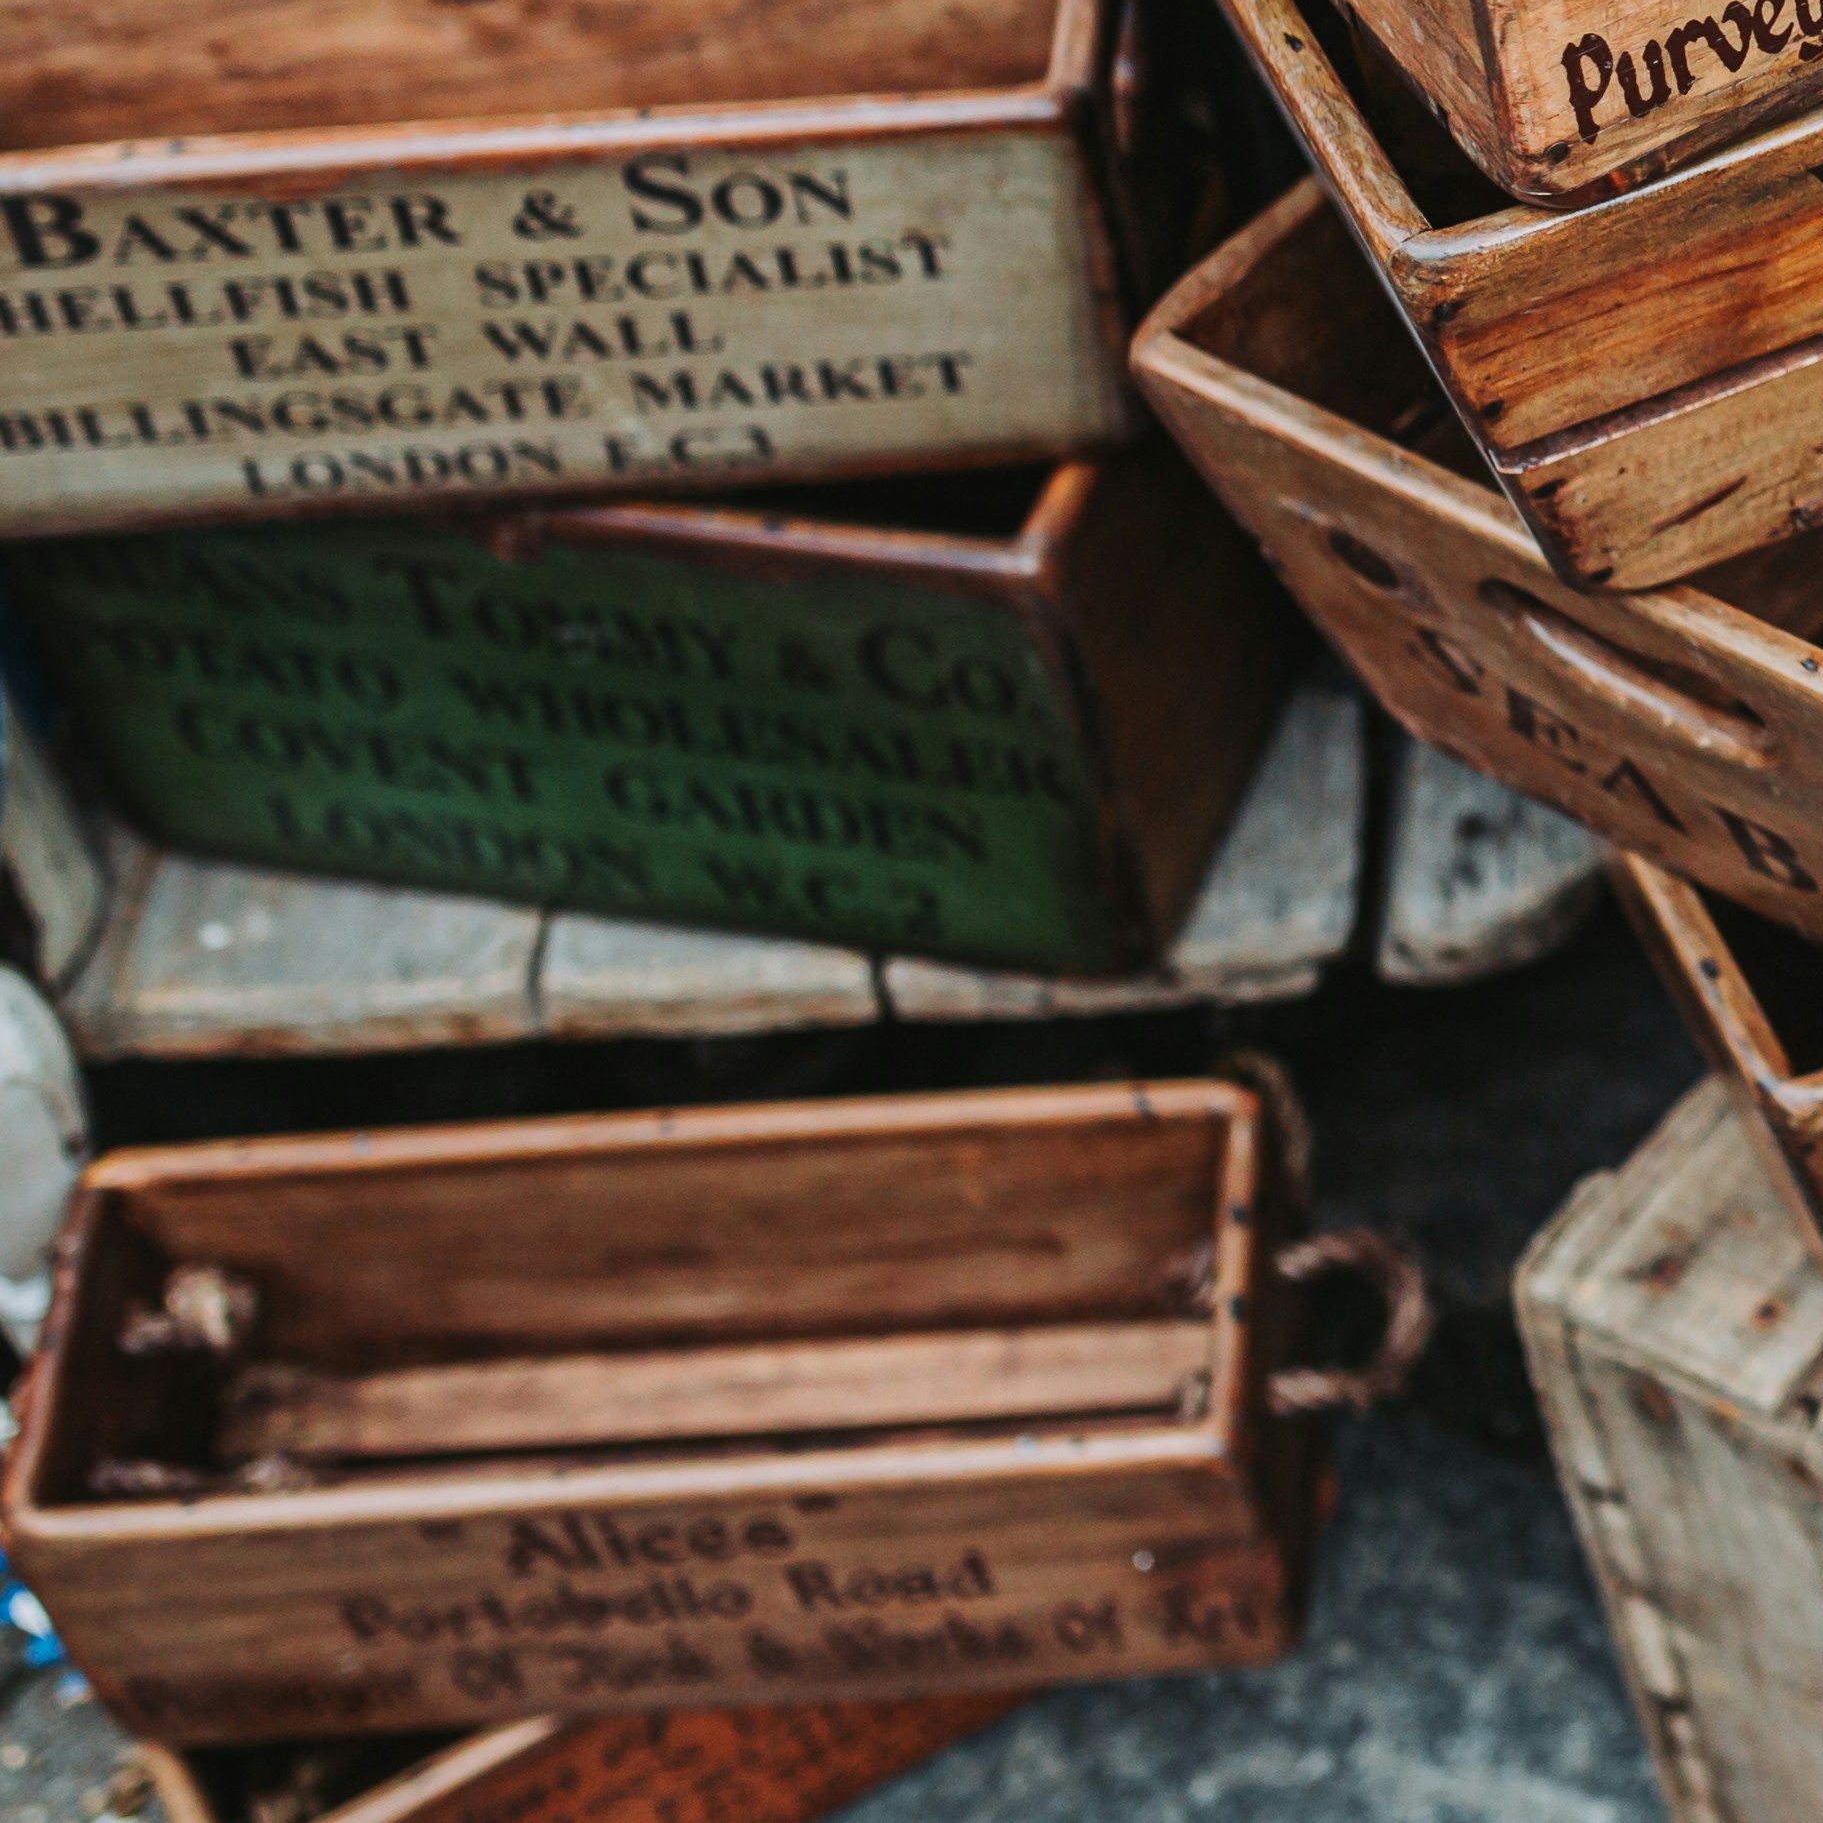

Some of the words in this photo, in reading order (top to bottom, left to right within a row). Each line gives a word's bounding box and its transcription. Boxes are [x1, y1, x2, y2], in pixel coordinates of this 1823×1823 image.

[4, 189, 462, 270] BAXTER
[511, 189, 584, 241] &
[620, 150, 858, 237] SON
[0, 266, 413, 339] HELLFISH
[475, 231, 952, 309] SPECIALIST
[230, 324, 438, 380] EAST
[481, 310, 726, 365] WALL
[631, 350, 975, 417] MARKET
[243, 439, 563, 498] LONDON
